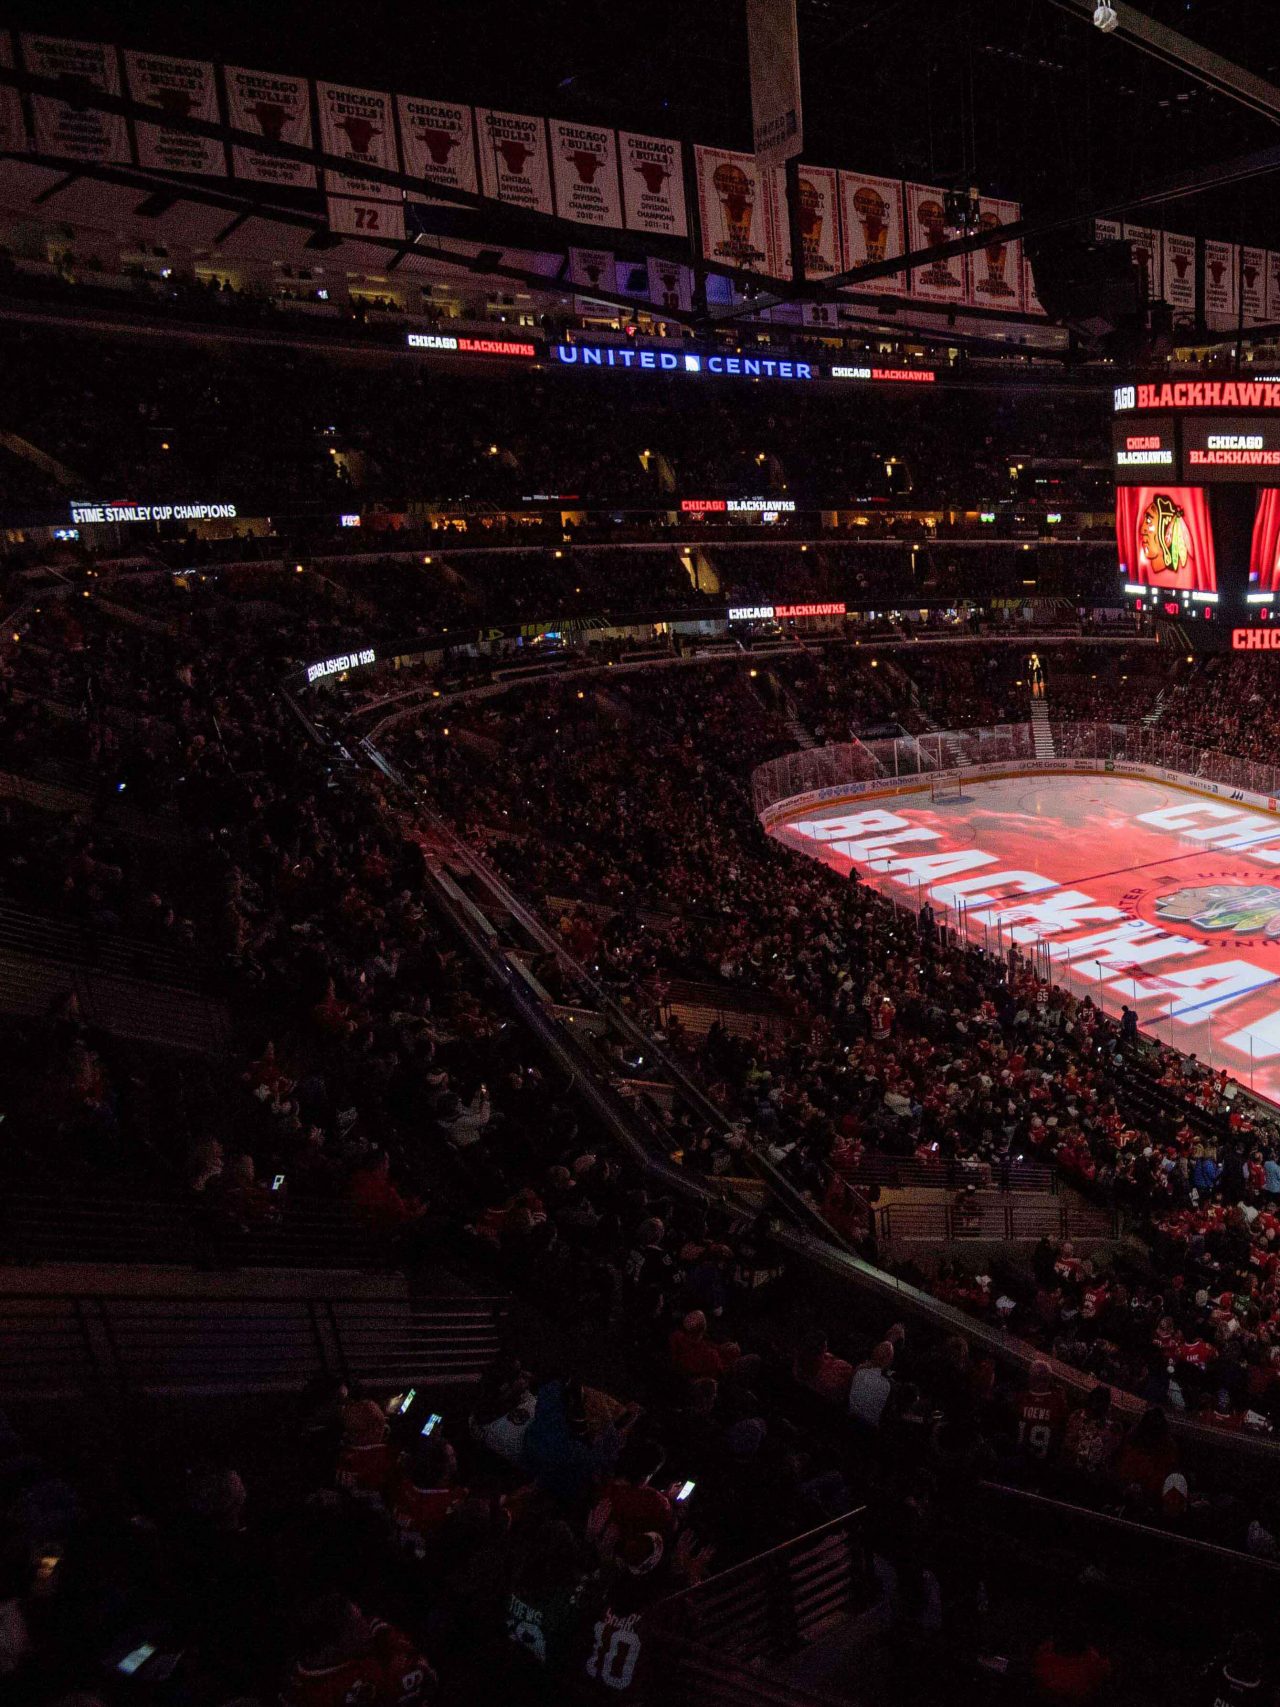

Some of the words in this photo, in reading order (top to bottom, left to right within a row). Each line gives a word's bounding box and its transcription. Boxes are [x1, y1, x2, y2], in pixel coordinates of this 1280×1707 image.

[236, 73, 298, 93] CHICAGO
[326, 89, 385, 109] CHICAGO
[337, 103, 378, 119] BULLS
[407, 103, 462, 120] CHICAGO
[418, 116, 457, 131] BULLS
[485, 115, 537, 132] CHICAGO
[494, 128, 531, 142] BULLS
[558, 126, 607, 143] CHICAGO
[568, 140, 601, 152] BULLS
[628, 138, 674, 154] CHICAGO
[636, 150, 668, 164] BULLS
[425, 164, 457, 175] CENTRAL
[425, 174, 458, 185] DIVISION
[502, 175, 531, 185] CENTRAL
[501, 183, 533, 194] DIVISION
[573, 183, 601, 194] CENTRAL
[572, 193, 603, 203] DIVISION
[641, 194, 668, 204] CENTRAL
[569, 202, 610, 213] CHAMPIONS
[641, 202, 670, 212] DIVISION
[354, 207, 379, 230] 72
[637, 210, 675, 222] CHAMPIONS
[408, 334, 457, 349] CHICAGO
[458, 338, 535, 356] BLACKHAWKS
[559, 345, 678, 369] UNITED
[708, 357, 812, 379] CENTER
[832, 367, 871, 379] CHICAGO
[872, 369, 935, 381] BLACKHAWKS
[1126, 436, 1160, 449] CHICAGO
[1208, 436, 1263, 450] CHICAGO
[1117, 451, 1172, 465] BLACKHAWKS
[1190, 451, 1280, 465] BLACKHAWKS
[682, 501, 725, 512] CHICAGO
[726, 501, 796, 511] BLACKHAWKS
[72, 507, 105, 524] 6-TIME
[106, 506, 151, 522] STANLEY
[152, 505, 172, 520] CUP
[173, 504, 236, 519] CHAMPIONS
[729, 607, 774, 619] CHICAGO
[775, 603, 846, 618] BLACKHAWKS
[308, 656, 349, 682] ESTABLISHED
[350, 654, 358, 668] IN
[358, 649, 375, 666] 1926
[1044, 761, 1068, 770] Group
[1023, 1406, 1050, 1420] TOEWS
[1018, 1420, 1051, 1456] 19
[586, 1620, 642, 1690] 10
